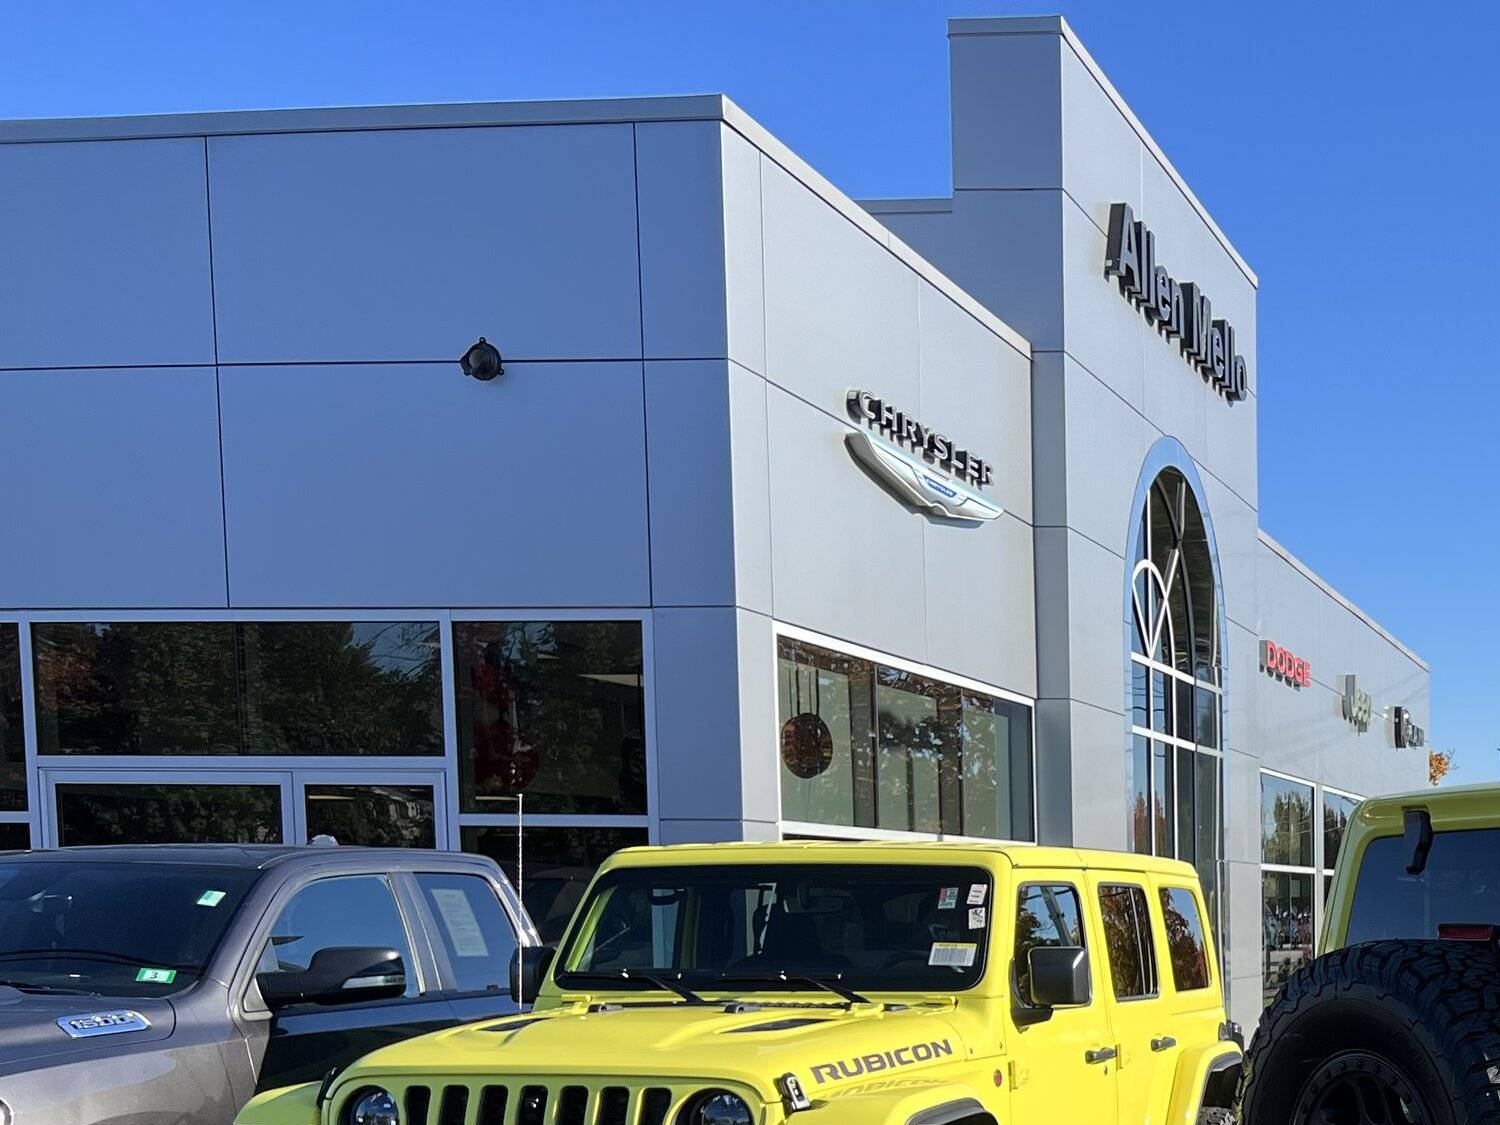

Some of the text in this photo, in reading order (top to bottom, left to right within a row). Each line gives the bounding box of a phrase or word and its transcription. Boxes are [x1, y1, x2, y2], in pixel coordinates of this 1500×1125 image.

[1105, 202, 1248, 402] Allen Mello
[849, 389, 994, 486] CHRYSLER
[1262, 640, 1312, 688] DODGE
[809, 1039, 953, 1084] RUBICON
